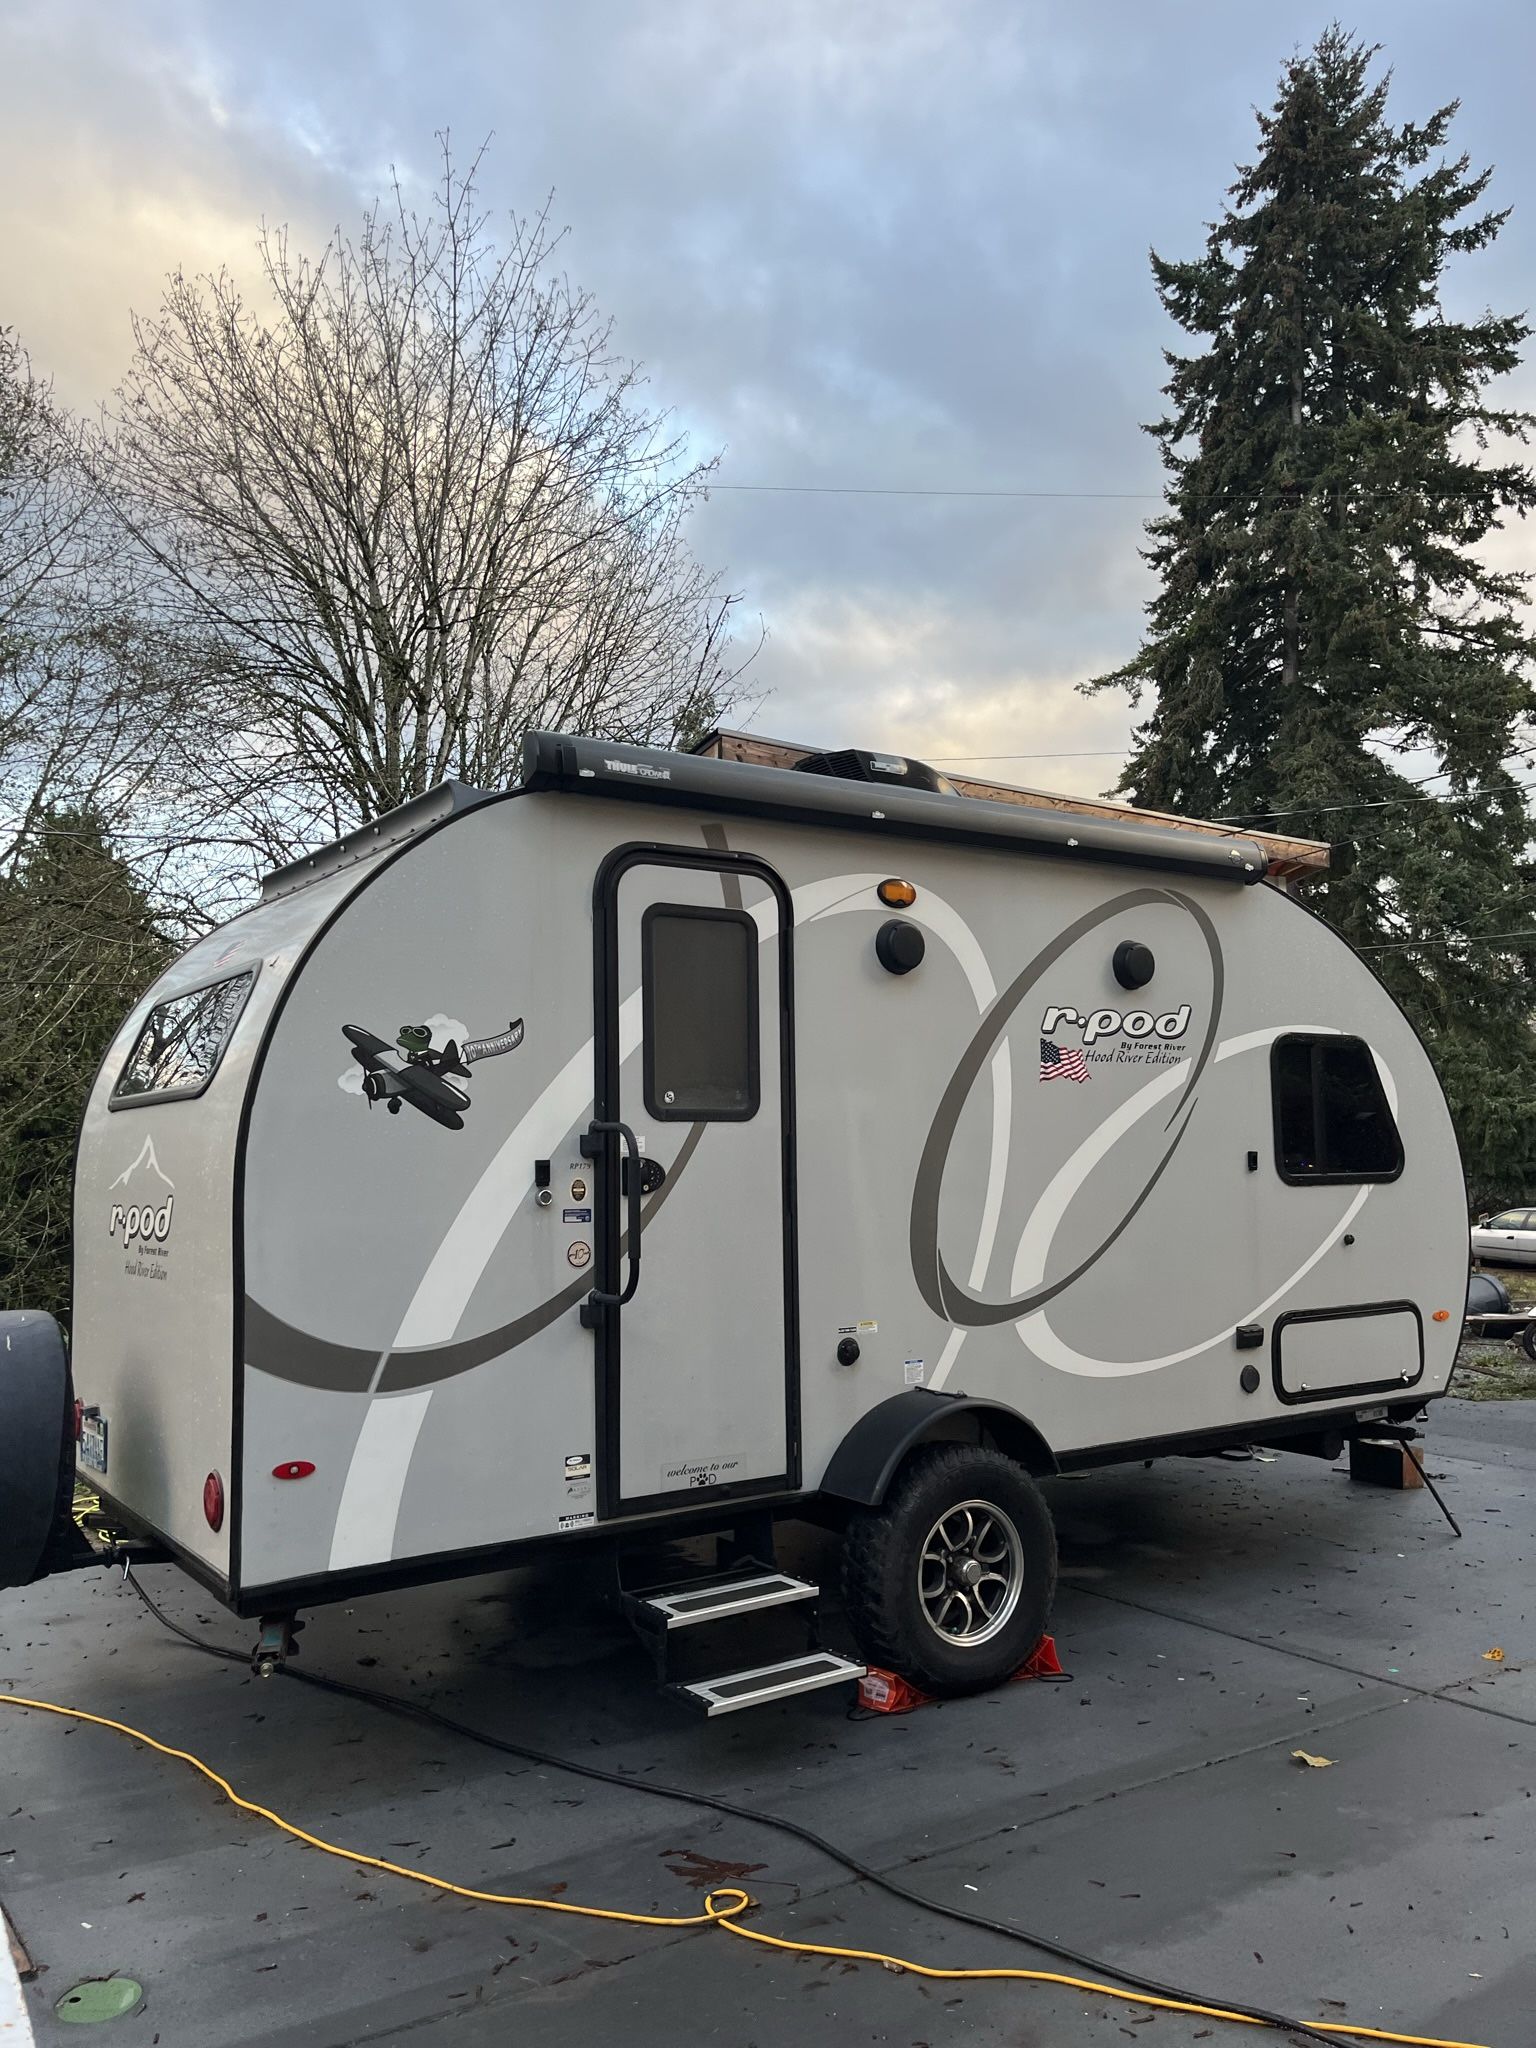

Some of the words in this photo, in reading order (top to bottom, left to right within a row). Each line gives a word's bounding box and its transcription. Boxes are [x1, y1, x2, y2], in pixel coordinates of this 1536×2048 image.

[1120, 1041, 1133, 1051] By
[1134, 1041, 1162, 1051] Forest
[1163, 1043, 1187, 1052] River
[1084, 1048, 1116, 1062] Hood
[1115, 1050, 1143, 1064] River
[1144, 1049, 1182, 1065] Edition
[567, 1464, 588, 1472] SOLAR
[667, 1463, 709, 1478] welcome
[710, 1463, 720, 1472] to
[722, 1461, 739, 1471] our
